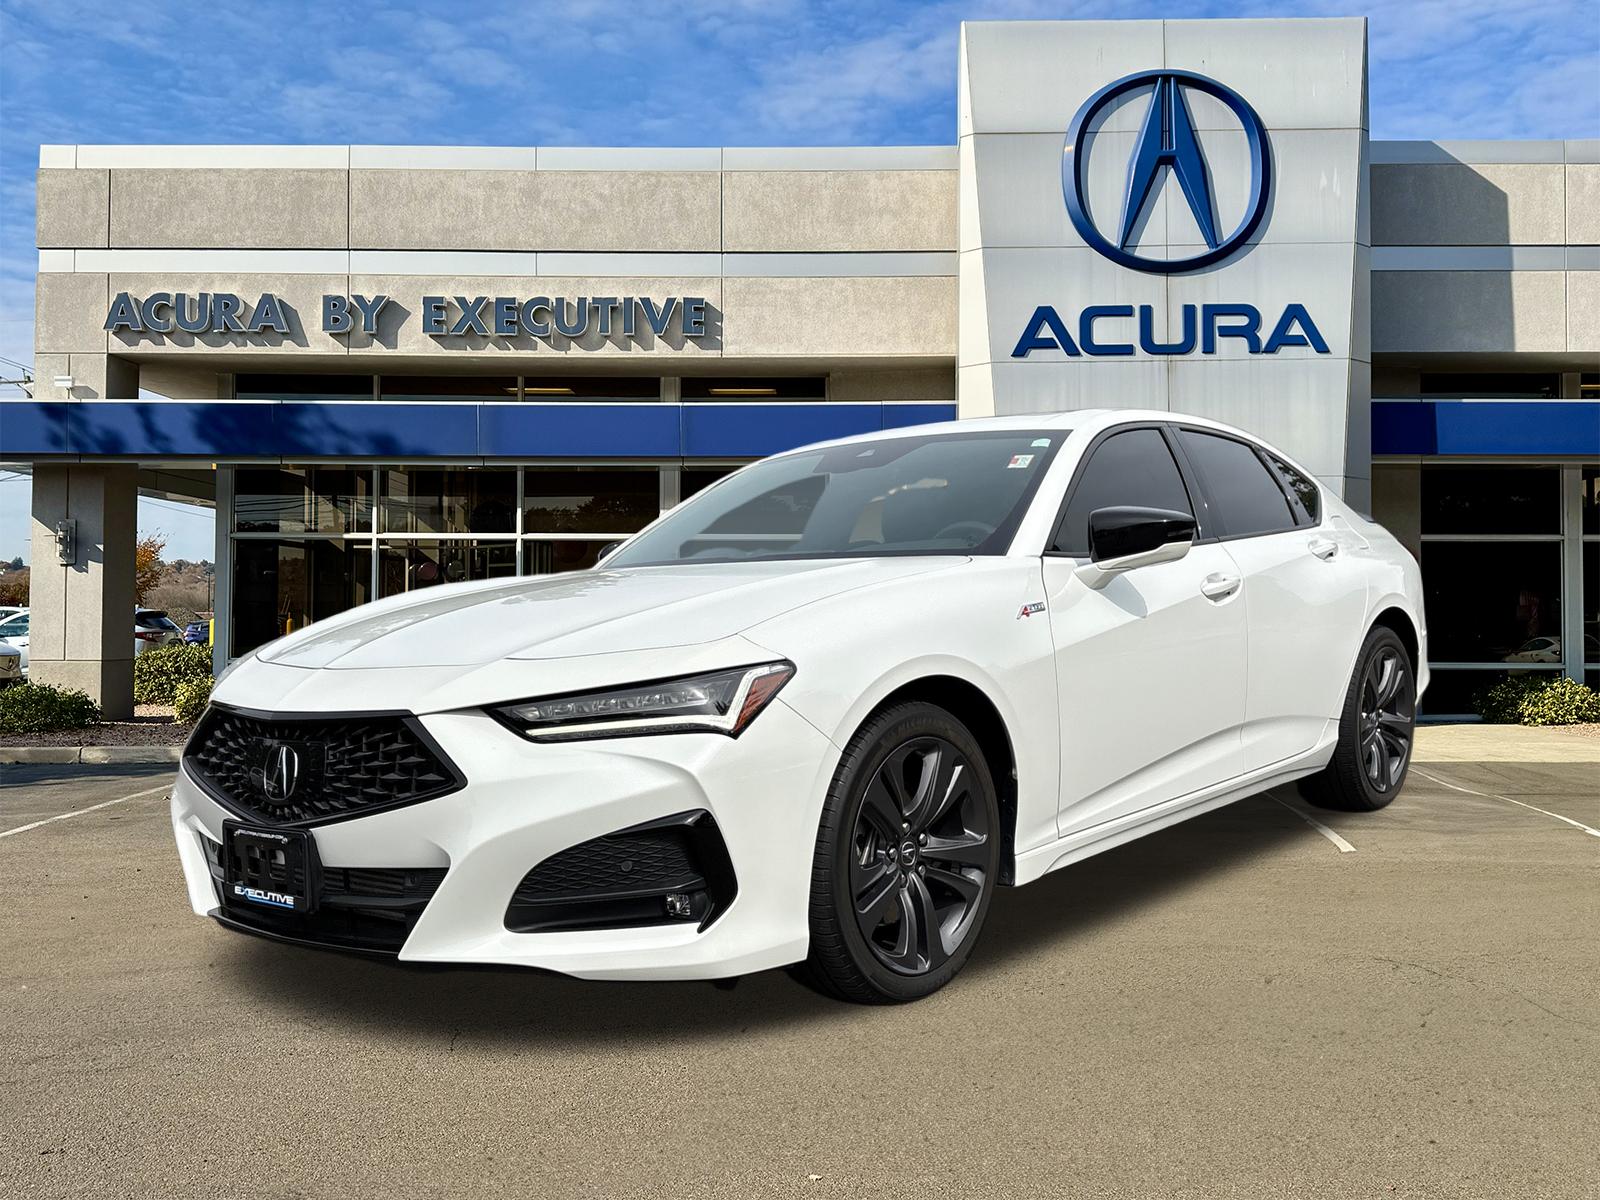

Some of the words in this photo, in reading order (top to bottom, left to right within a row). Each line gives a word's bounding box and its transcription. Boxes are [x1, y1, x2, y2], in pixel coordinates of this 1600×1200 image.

[103, 292, 290, 333] ACURA
[322, 295, 390, 334] BY
[422, 296, 707, 338] EXECUTIVE
[1010, 303, 1332, 357] ACURA
[234, 885, 295, 905] EXECUTIVE
